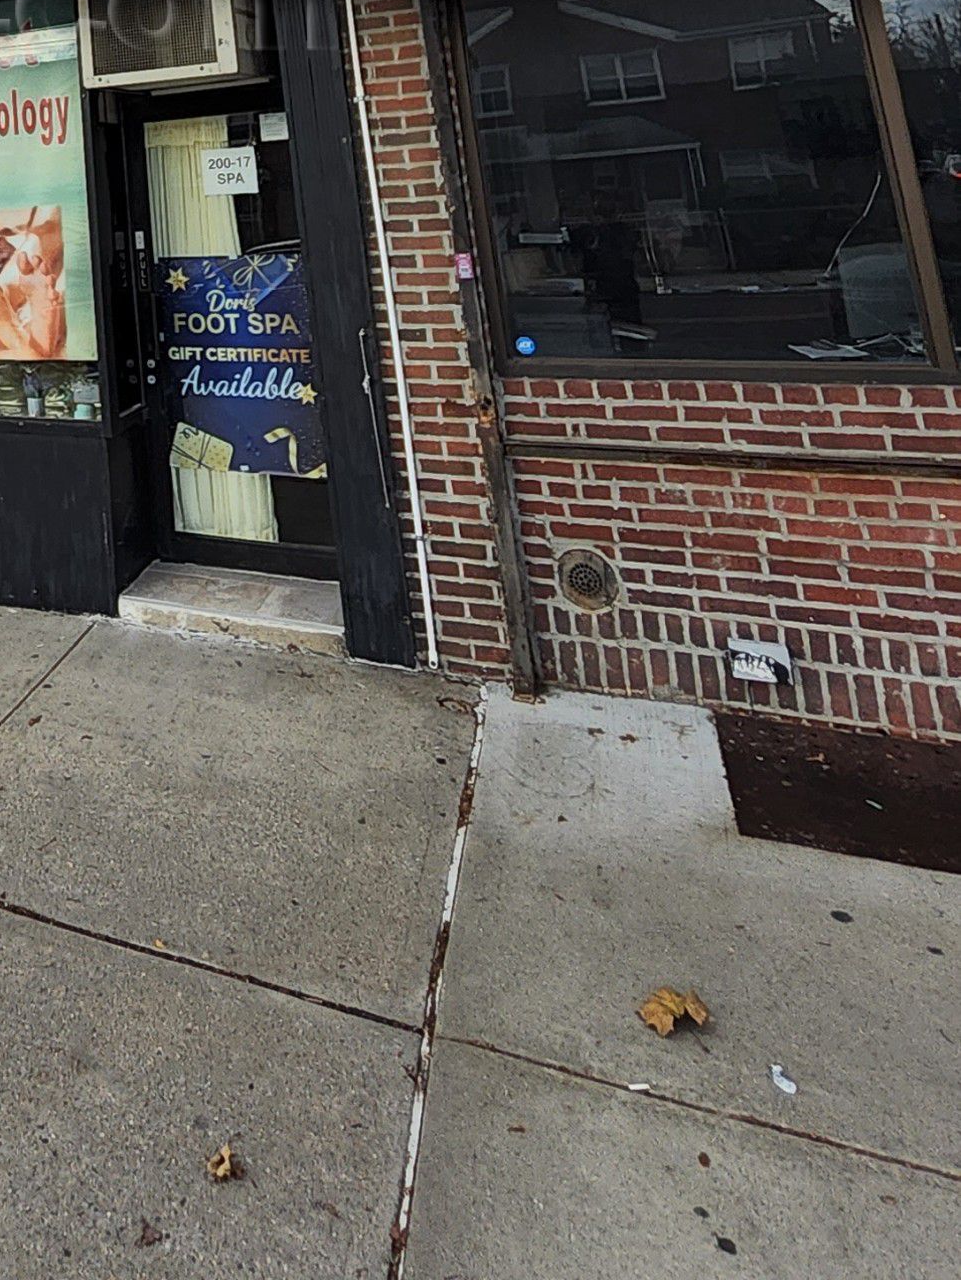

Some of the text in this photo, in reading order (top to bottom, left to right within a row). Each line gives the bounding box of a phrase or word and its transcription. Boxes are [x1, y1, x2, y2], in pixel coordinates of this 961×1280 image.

[208, 156, 251, 170] 200-17
[217, 173, 245, 185] SPA
[206, 289, 257, 312] Doris
[173, 313, 300, 335] FOOT SPA
[168, 347, 311, 363] GIFT CERTIFICATE
[181, 365, 303, 400] Available
